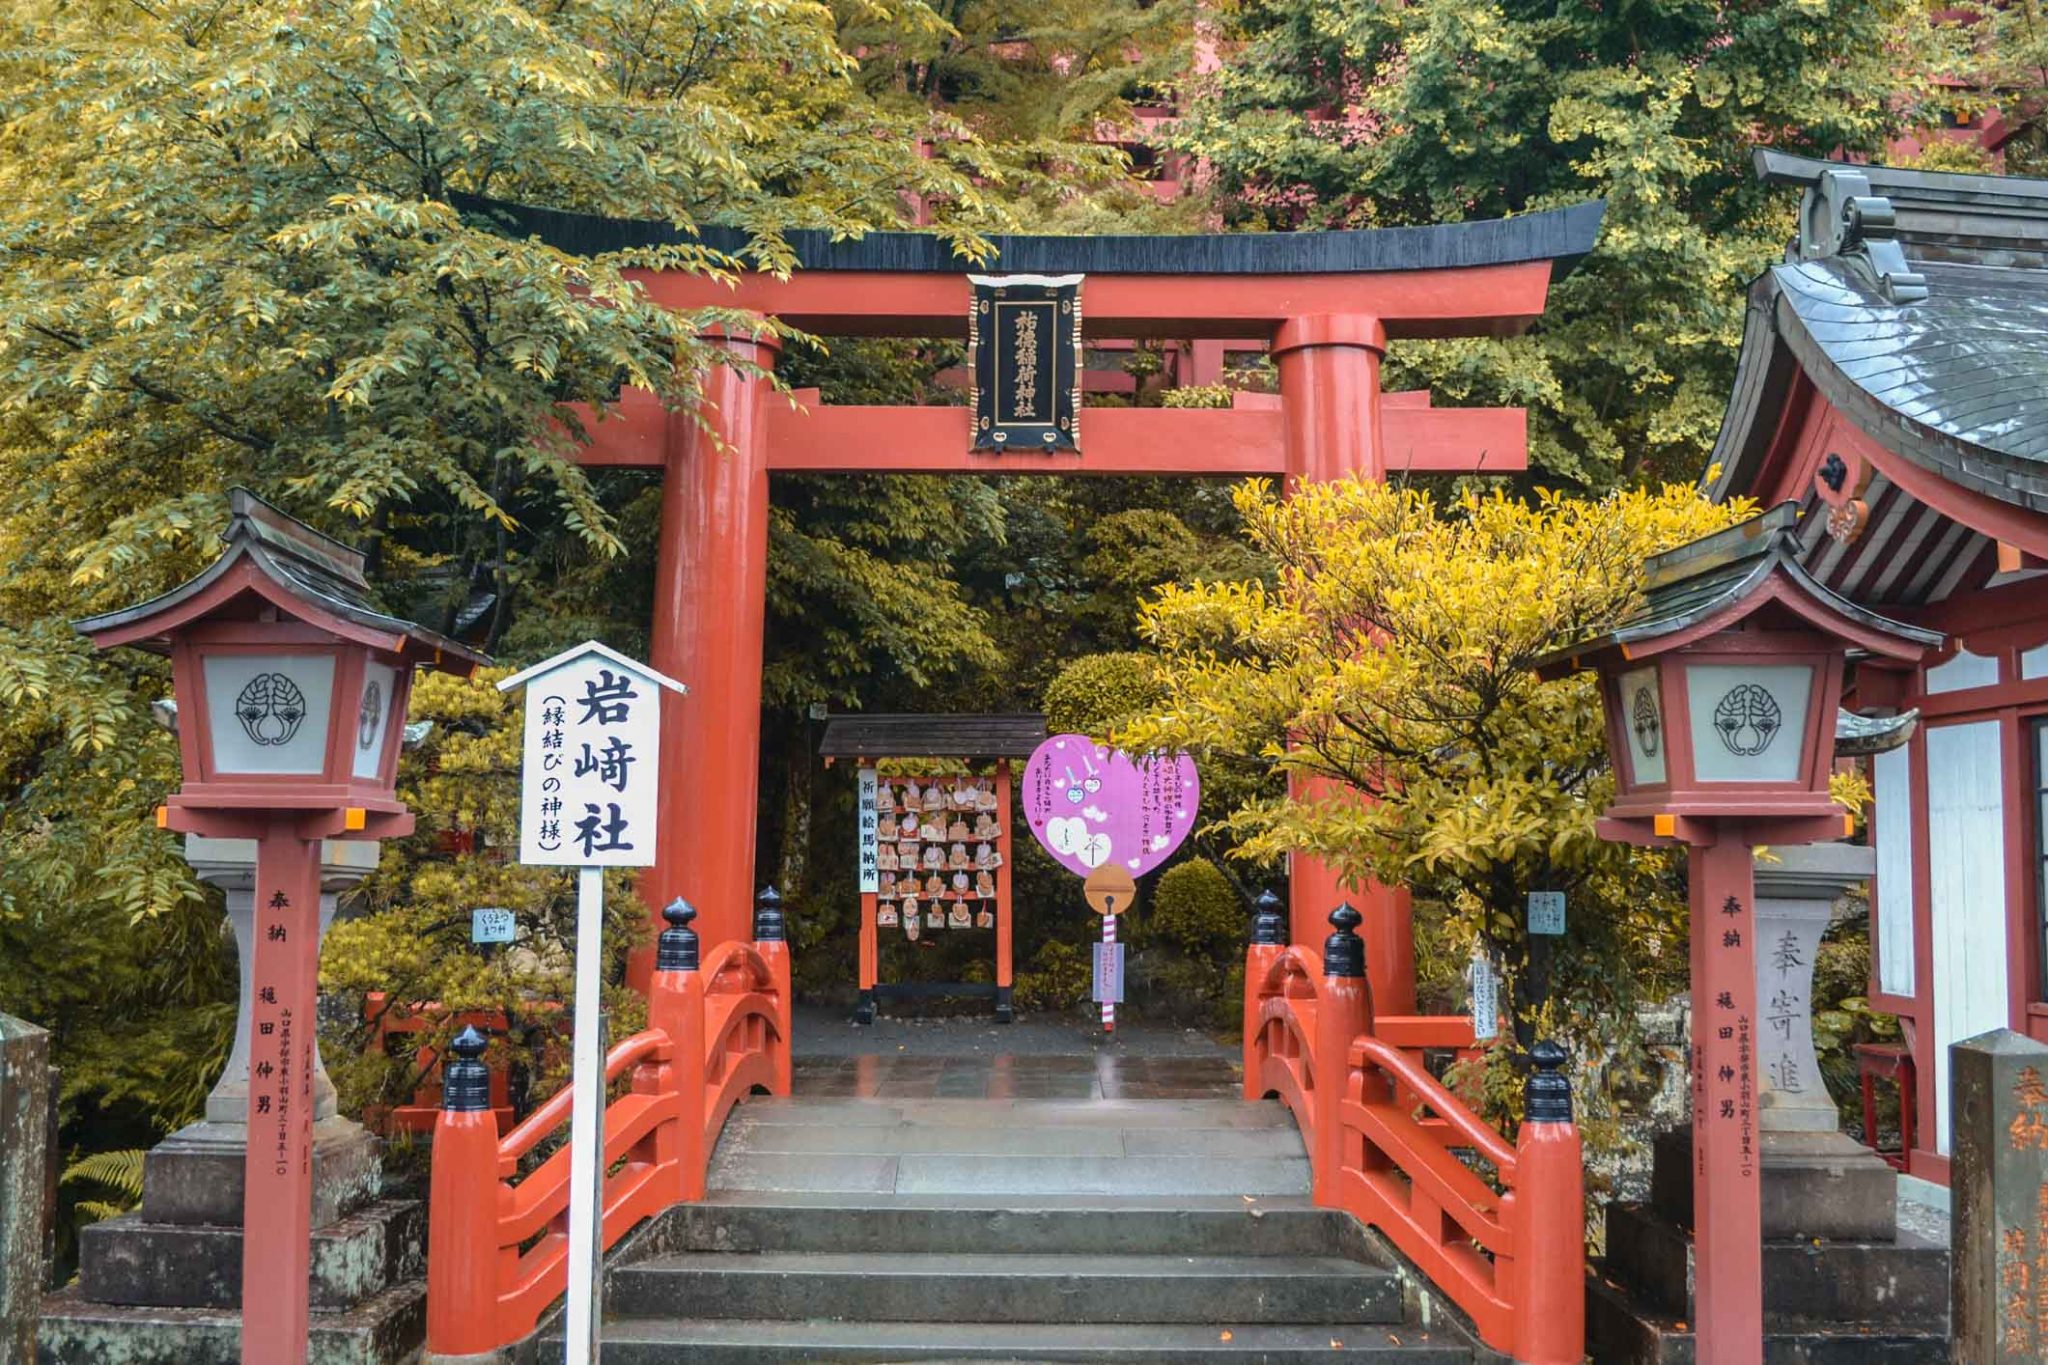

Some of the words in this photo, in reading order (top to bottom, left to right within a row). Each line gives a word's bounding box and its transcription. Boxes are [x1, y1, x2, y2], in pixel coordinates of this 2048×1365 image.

[861, 780, 876, 881] 祈願絵馬納所
[268, 889, 290, 943] 奉納
[1722, 895, 1742, 949] 奉納
[1766, 929, 1808, 1094] 奉寄進
